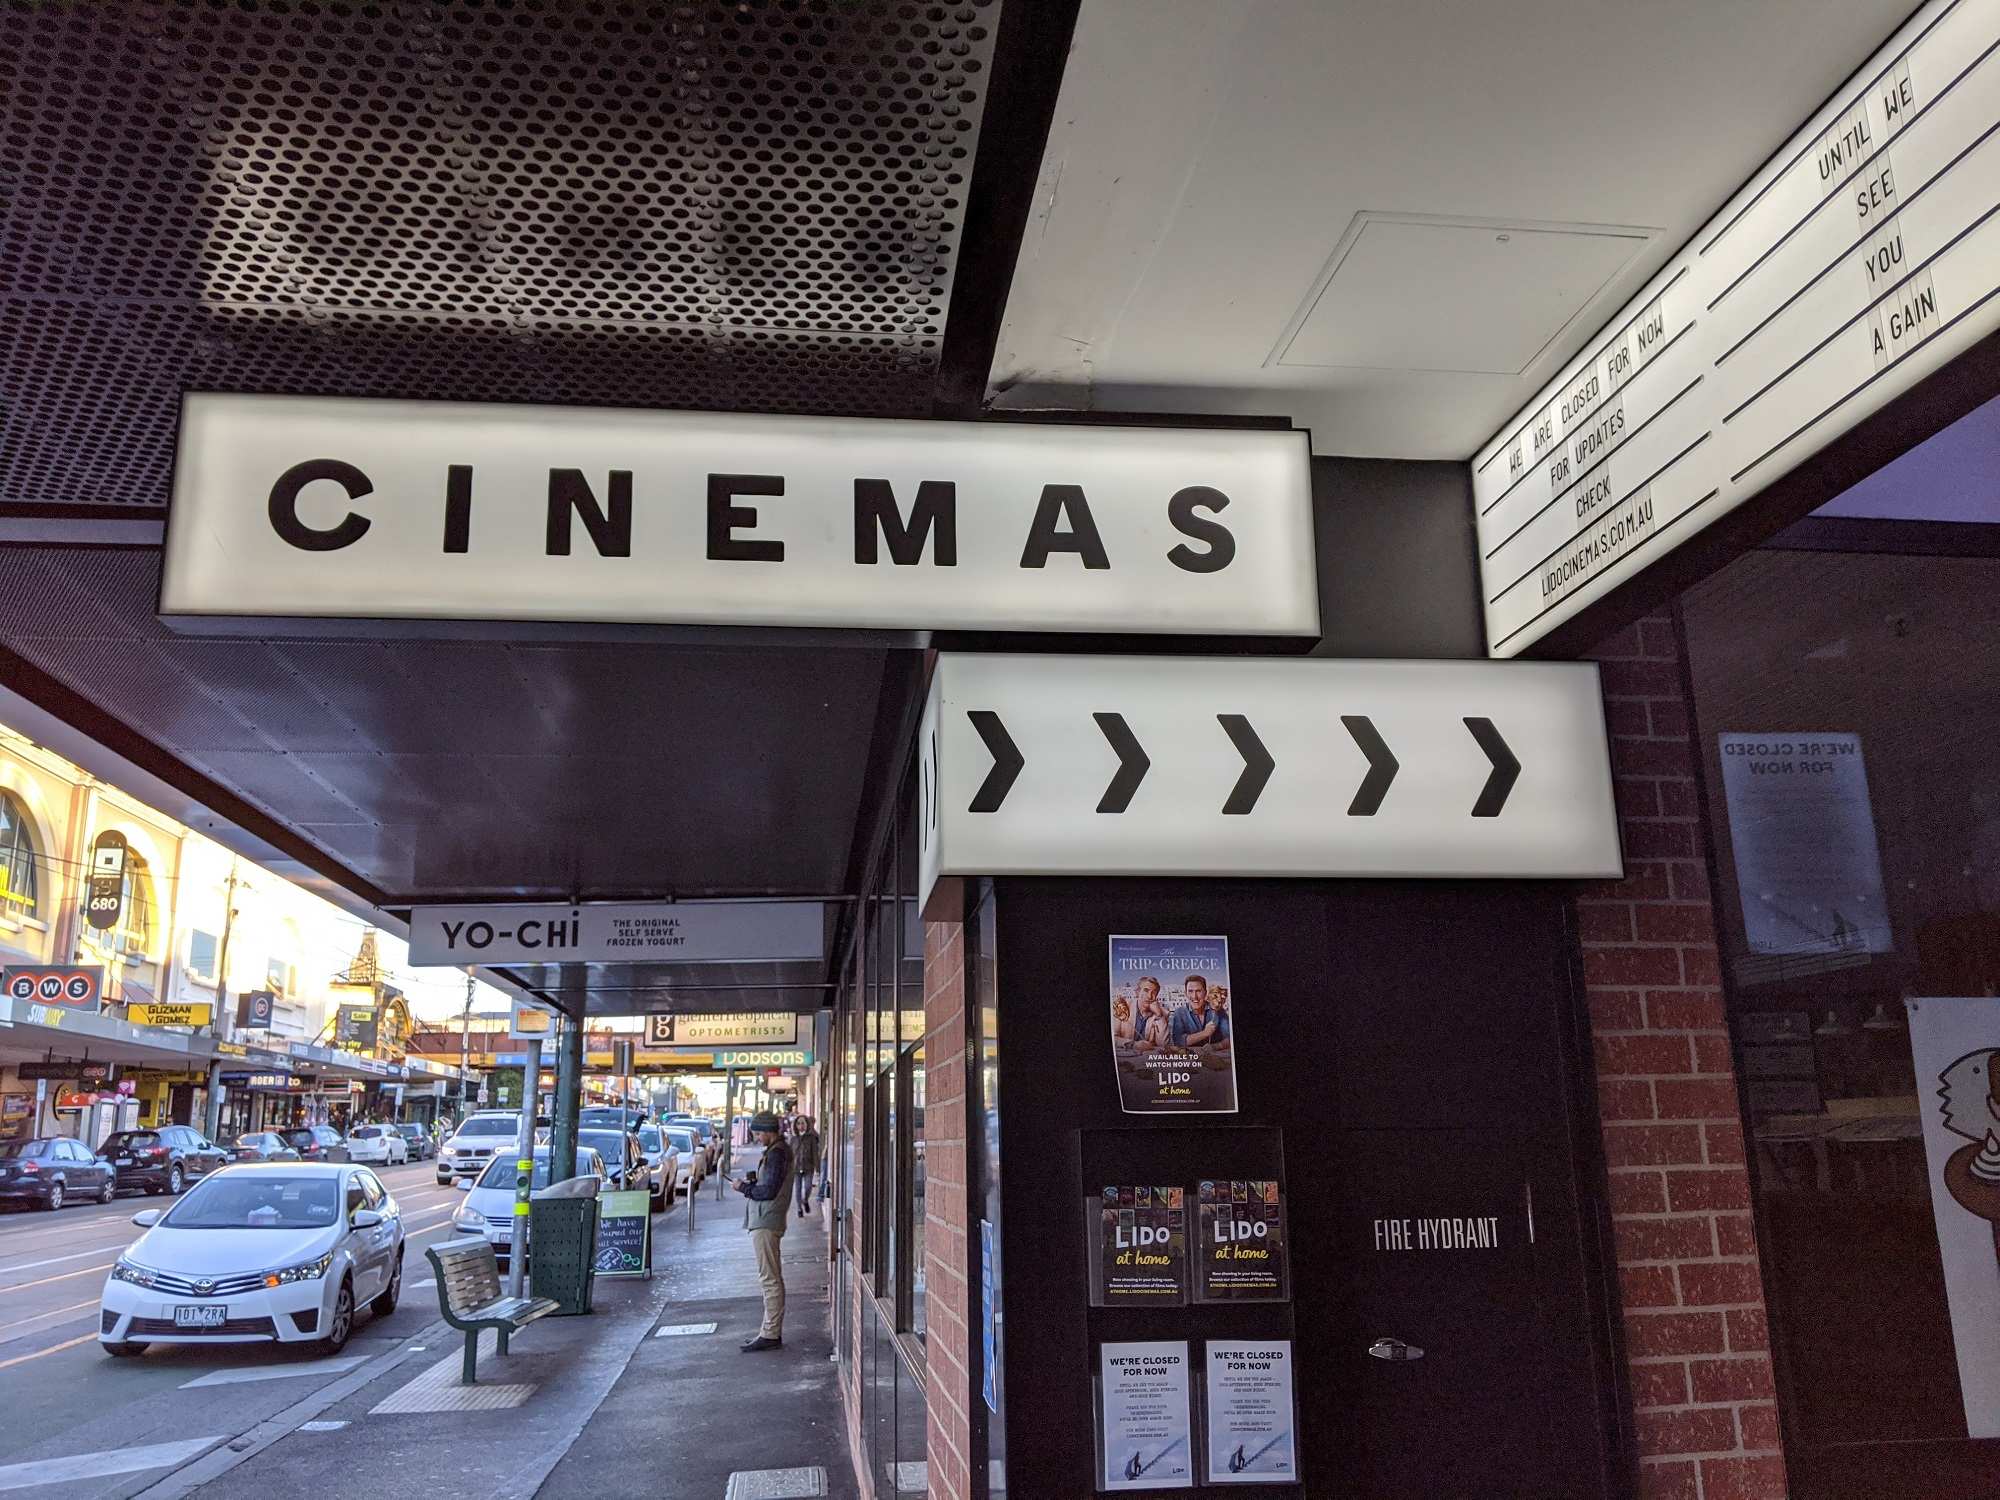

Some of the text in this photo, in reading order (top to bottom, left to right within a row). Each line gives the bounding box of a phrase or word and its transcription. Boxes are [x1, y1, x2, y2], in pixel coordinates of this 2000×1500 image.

[1818, 77, 1912, 180] UNTIL WE
[1857, 168, 1894, 218] SEE
[1866, 235, 1902, 283] YOU
[1509, 314, 1663, 474] WE ARE CLOSED FOR NOW
[1550, 408, 1624, 487] FOR UPDATES
[1576, 474, 1611, 518] CHECK
[267, 458, 1236, 575] CINEMAS
[1541, 498, 1653, 597] LIDOCINEMAS.COM.AU
[90, 897, 118, 911] 680
[613, 918, 681, 928] THE ORIGINAL
[618, 927, 674, 937] SELF SERVE
[606, 937, 686, 946] FROZEN YOGURT
[1119, 958, 1152, 970] TRIP
[1159, 958, 1219, 970] GREECE
[18, 982, 84, 995] BWS
[27, 1004, 65, 1026] SUBWAY
[148, 1004, 192, 1014] GUZMAN
[156, 1016, 191, 1024] GOMEZ
[689, 1026, 785, 1037] OPTOMETRISTS
[723, 1052, 804, 1065] Dobsons
[1158, 1072, 1191, 1085] LIDO
[1160, 1086, 1191, 1095] at home
[617, 1217, 637, 1228] have
[1115, 1226, 1170, 1248] LIDO
[1214, 1221, 1268, 1243] LIDO
[1374, 1217, 1498, 1250] FIRE HYDRANT
[1116, 1249, 1171, 1265] at home
[1215, 1244, 1269, 1259] at home
[205, 1308, 224, 1320] 2RA
[1110, 1356, 1180, 1366] WE'RE CLOSED
[1214, 1351, 1283, 1360] WE'RE CLOSED
[1123, 1367, 1168, 1376] FOR NOW
[1227, 1362, 1271, 1370] FOR NOW
